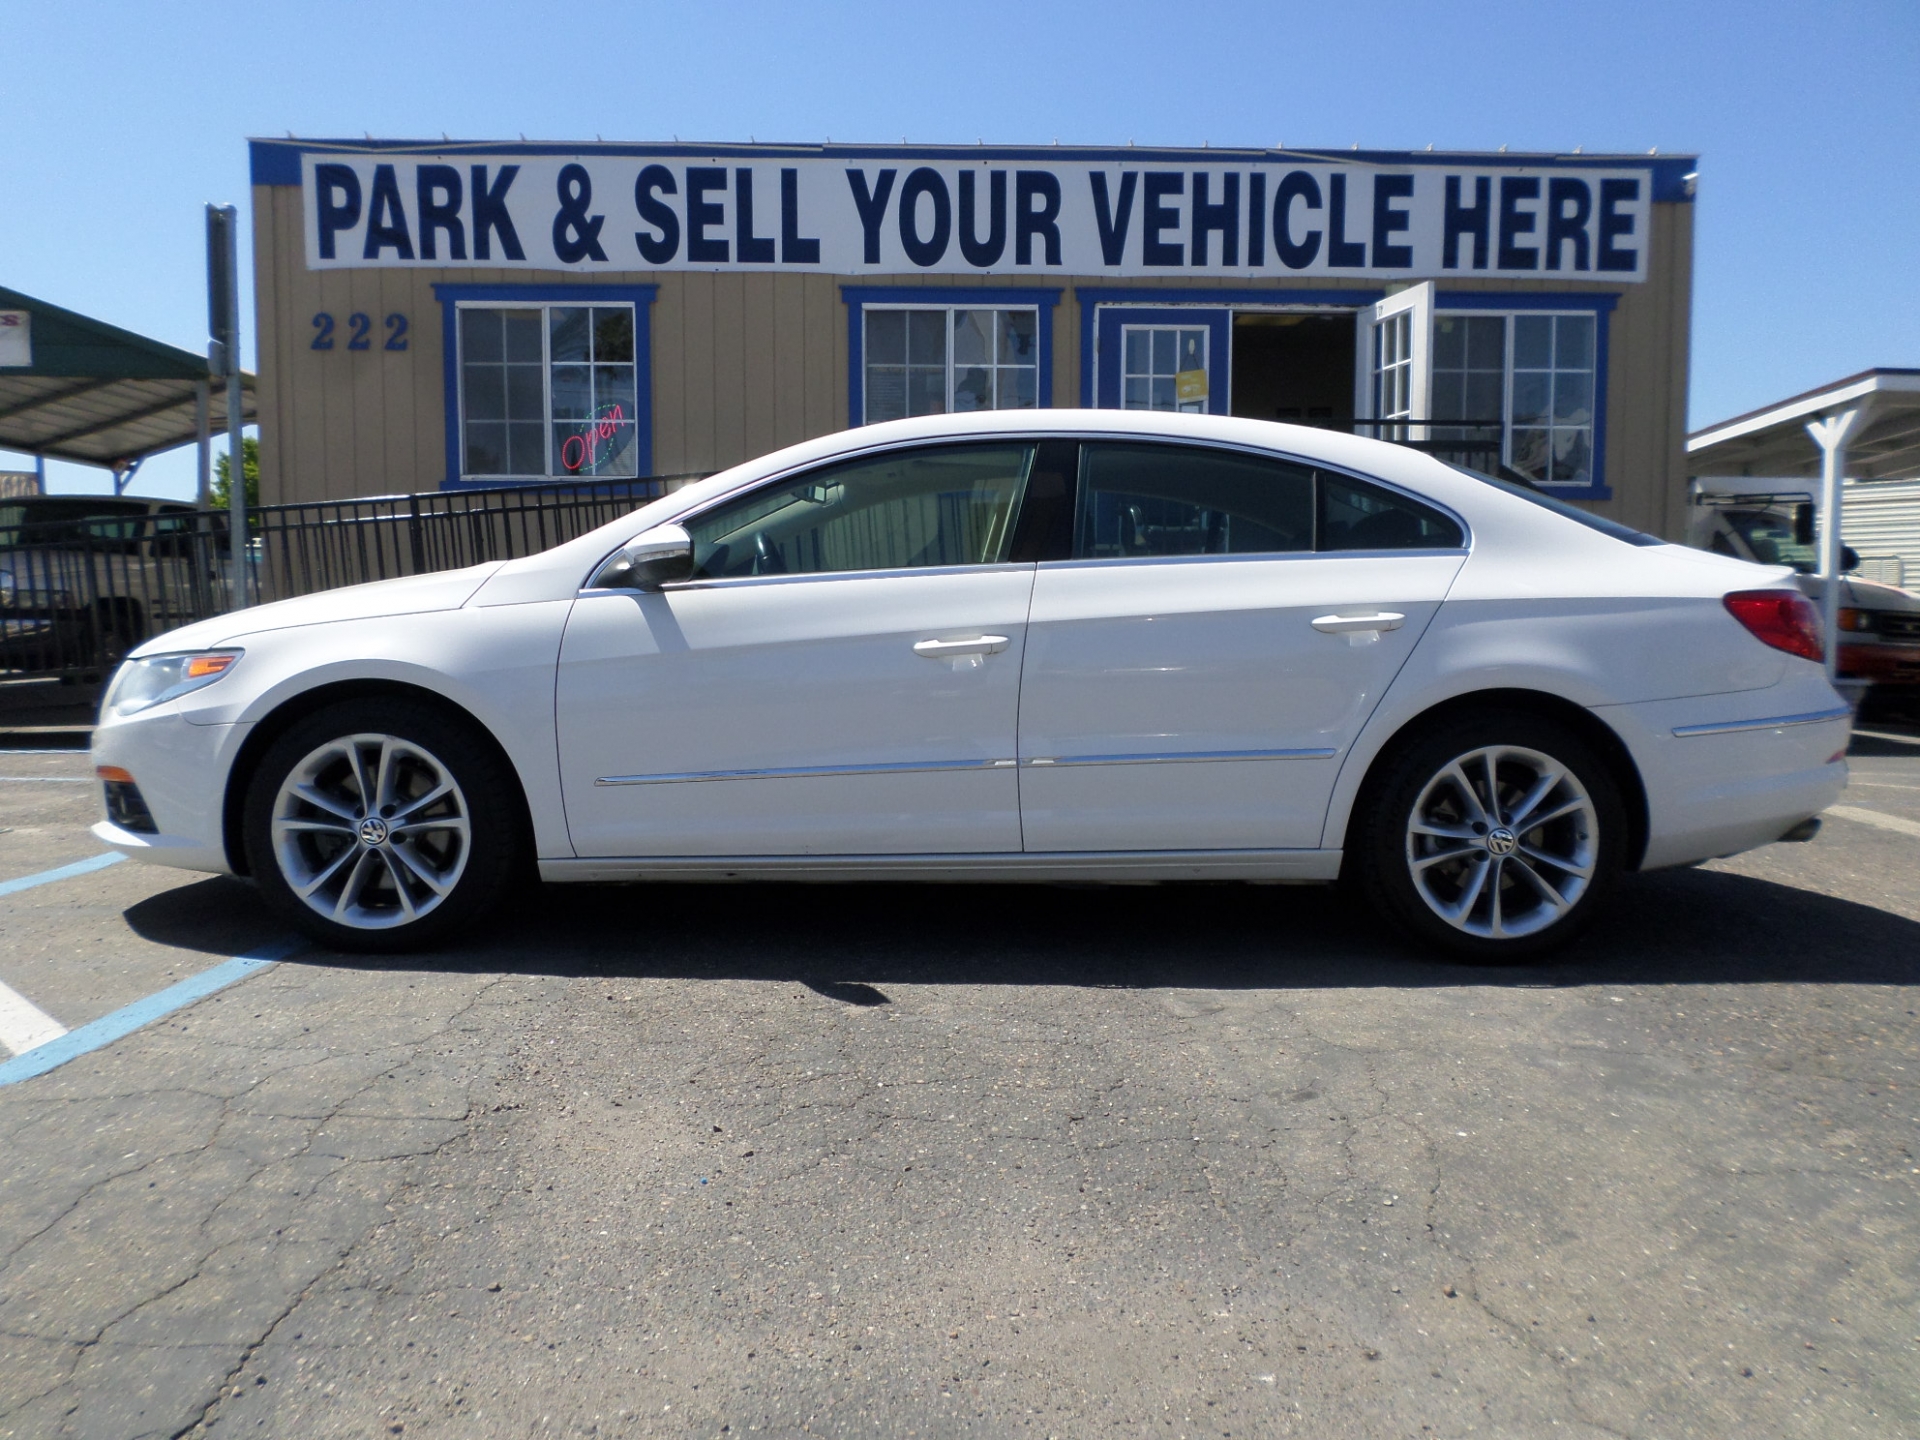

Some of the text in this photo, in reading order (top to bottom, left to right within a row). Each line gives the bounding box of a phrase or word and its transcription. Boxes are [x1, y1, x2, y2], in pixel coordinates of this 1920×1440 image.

[314, 162, 1641, 273] PARK & SELL YOUR VEHICLE HERE
[310, 312, 409, 351] 222
[562, 404, 625, 470] Open
